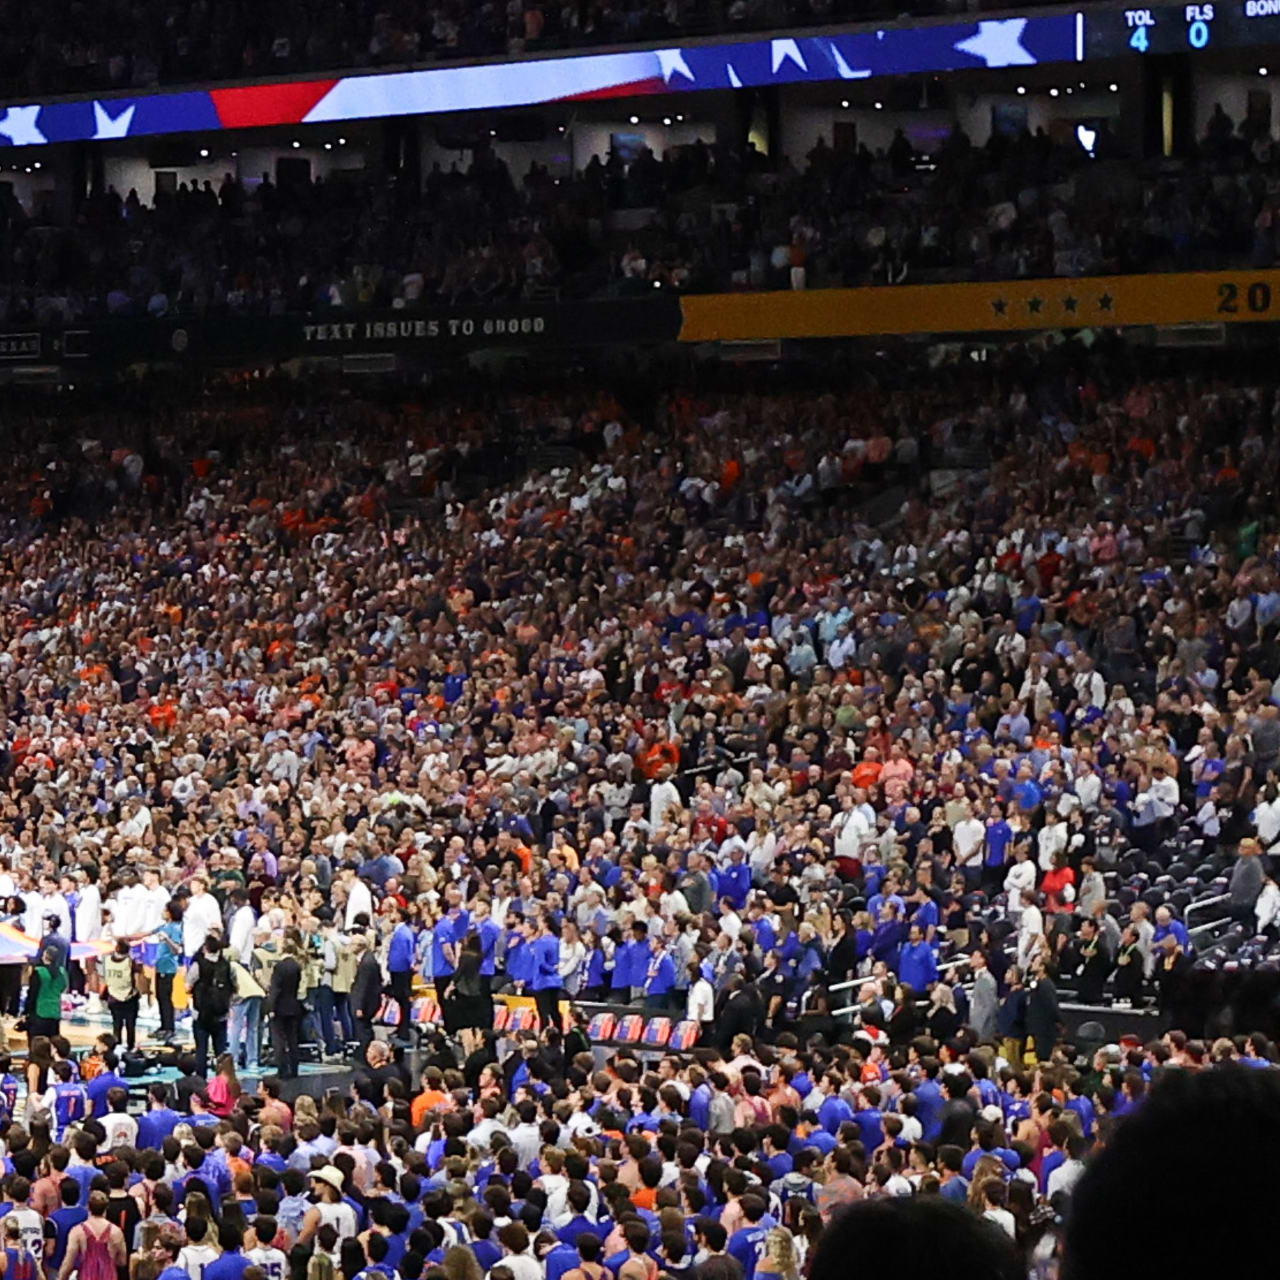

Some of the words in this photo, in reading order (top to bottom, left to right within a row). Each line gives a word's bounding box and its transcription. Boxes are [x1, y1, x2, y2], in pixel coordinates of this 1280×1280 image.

[1125, 10, 1155, 26] TOL
[1186, 5, 1214, 22] FLS
[1130, 26, 1149, 53] 4
[1190, 21, 1208, 48] 0
[1218, 283, 1272, 313] 20
[304, 323, 356, 341] TEXT
[365, 321, 439, 338] ISSUES
[449, 319, 474, 336] TO
